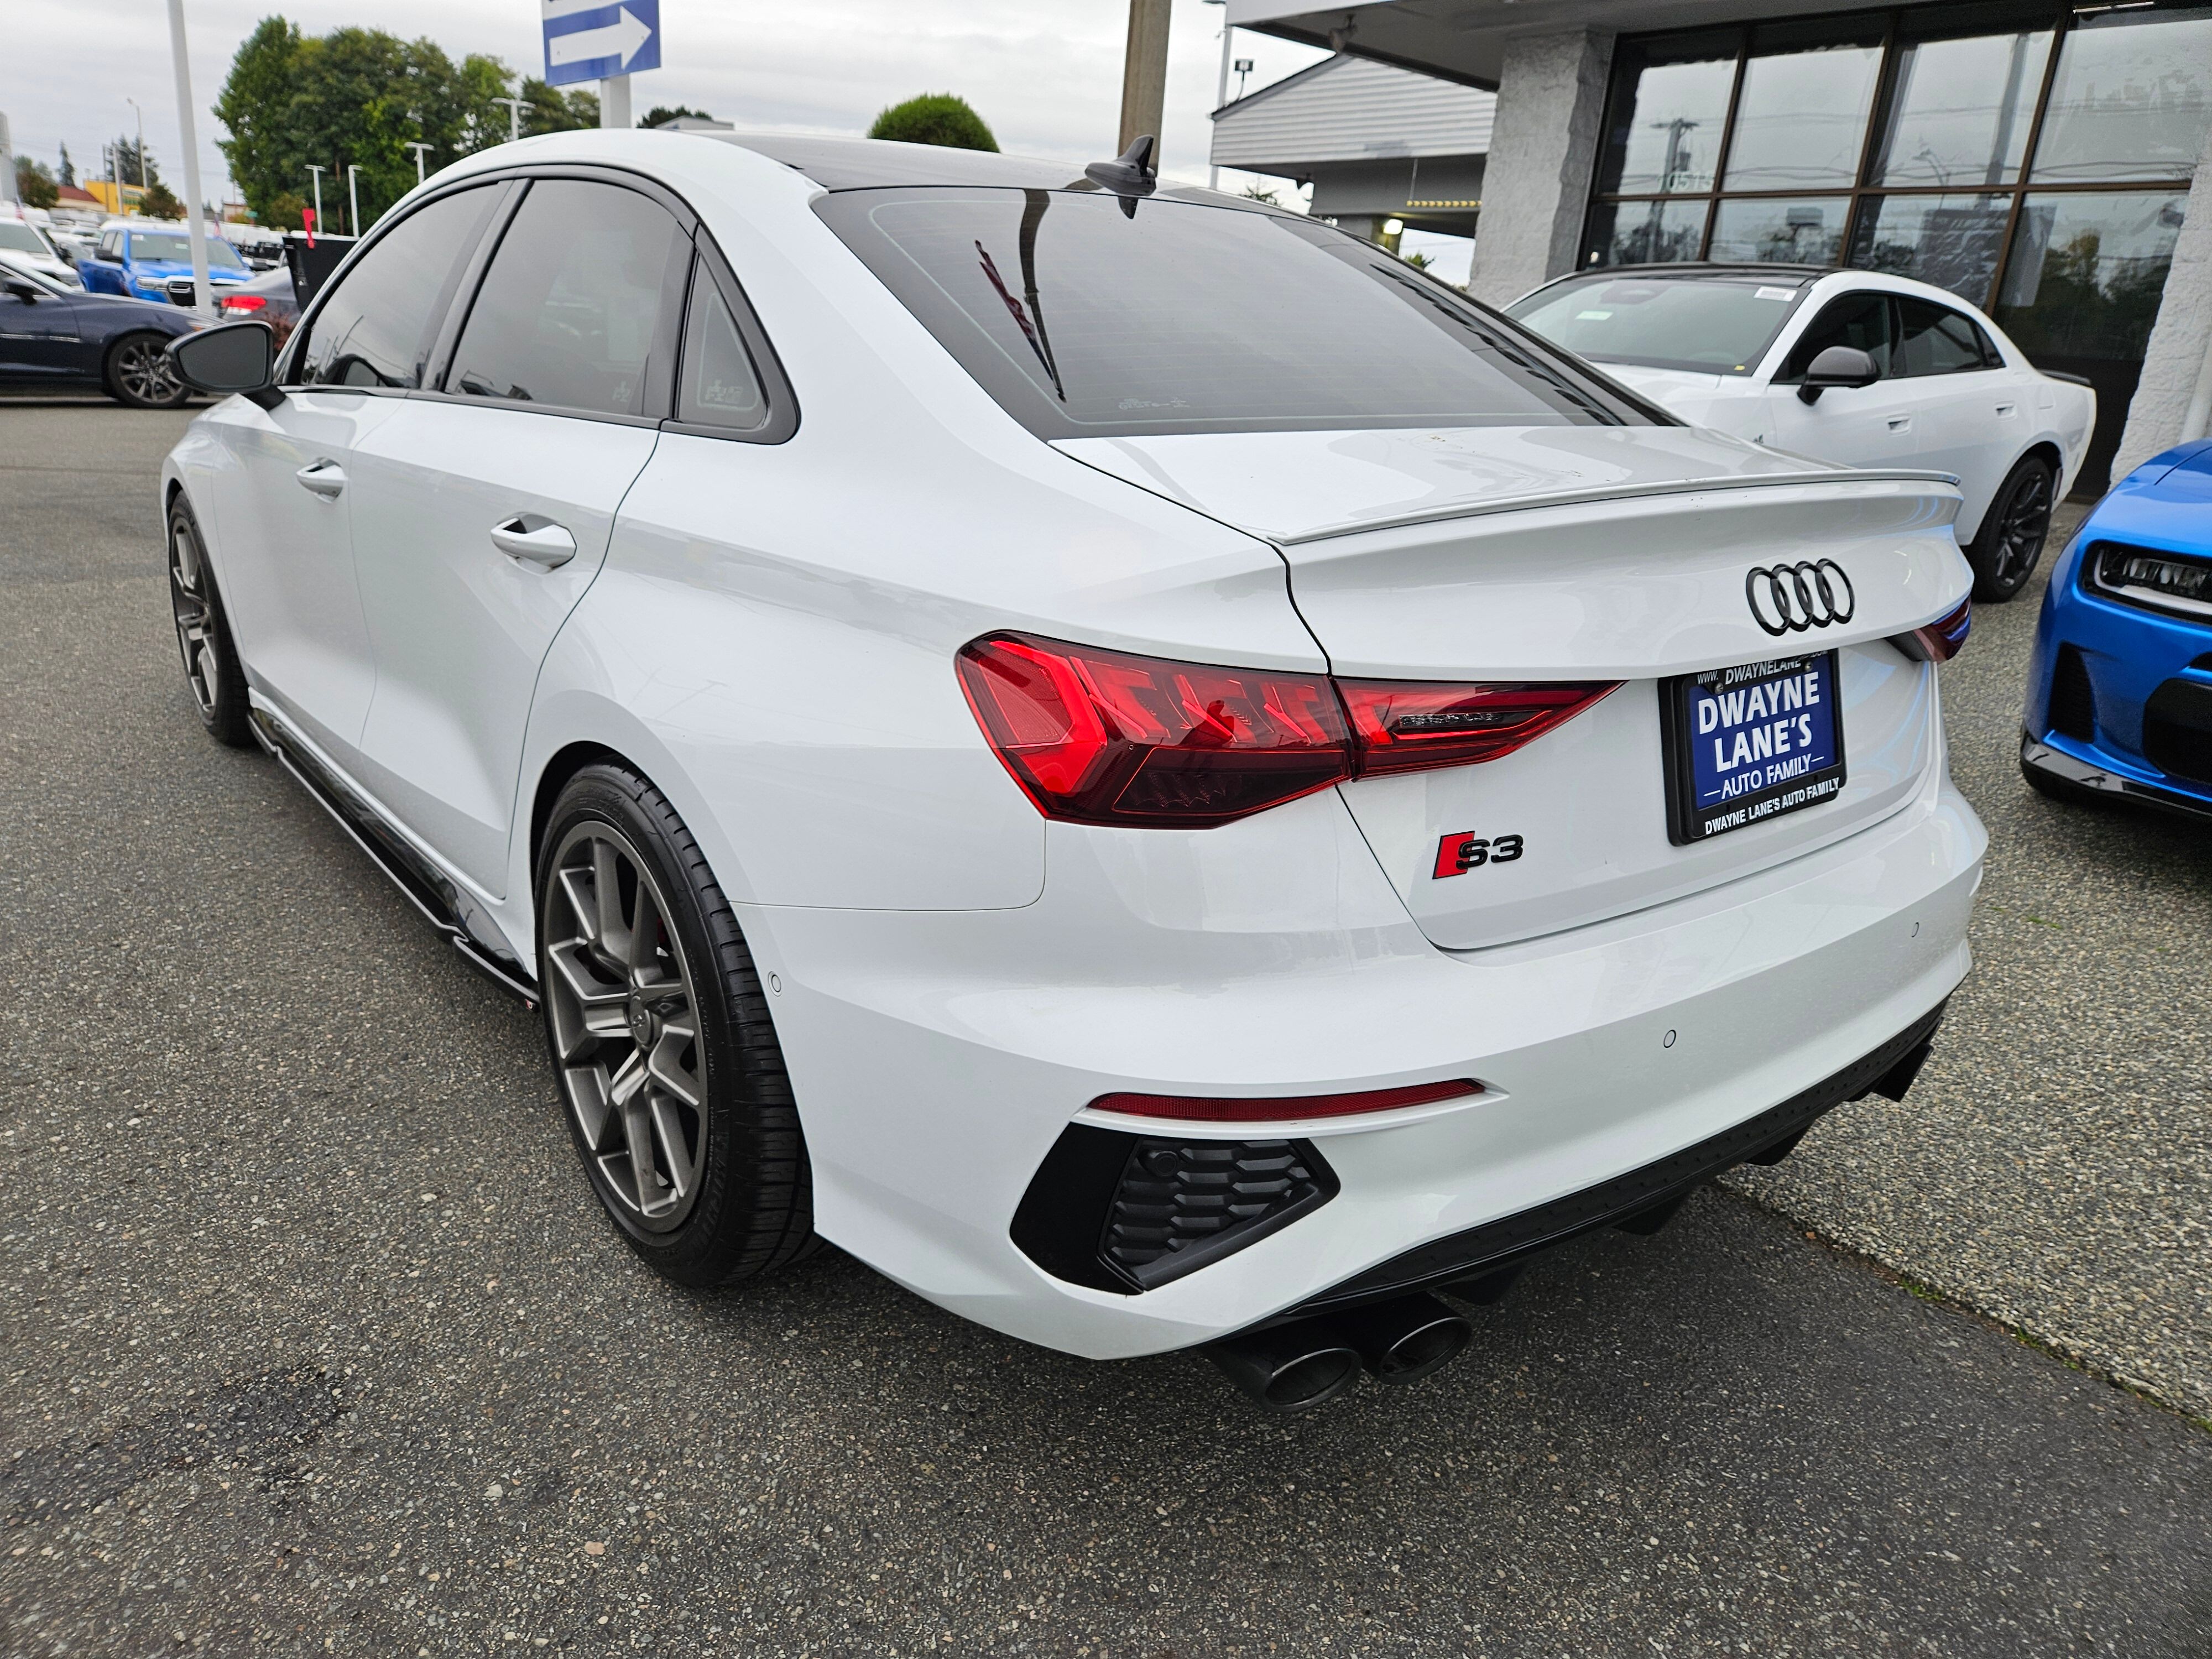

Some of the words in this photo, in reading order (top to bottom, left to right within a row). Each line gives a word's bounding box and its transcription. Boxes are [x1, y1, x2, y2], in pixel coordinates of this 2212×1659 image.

[1698, 671, 1820, 734] DWAYNE
[1715, 713, 1813, 773] LANE'S
[1721, 770, 1762, 799] AUTO
[1766, 753, 1812, 785] FAMILY
[1705, 808, 1746, 835] DWAYNE
[1749, 797, 1780, 820] LANE'S
[1782, 790, 1806, 808] AUTO
[1806, 777, 1839, 800] FAMILY
[1455, 834, 1524, 870] S3
